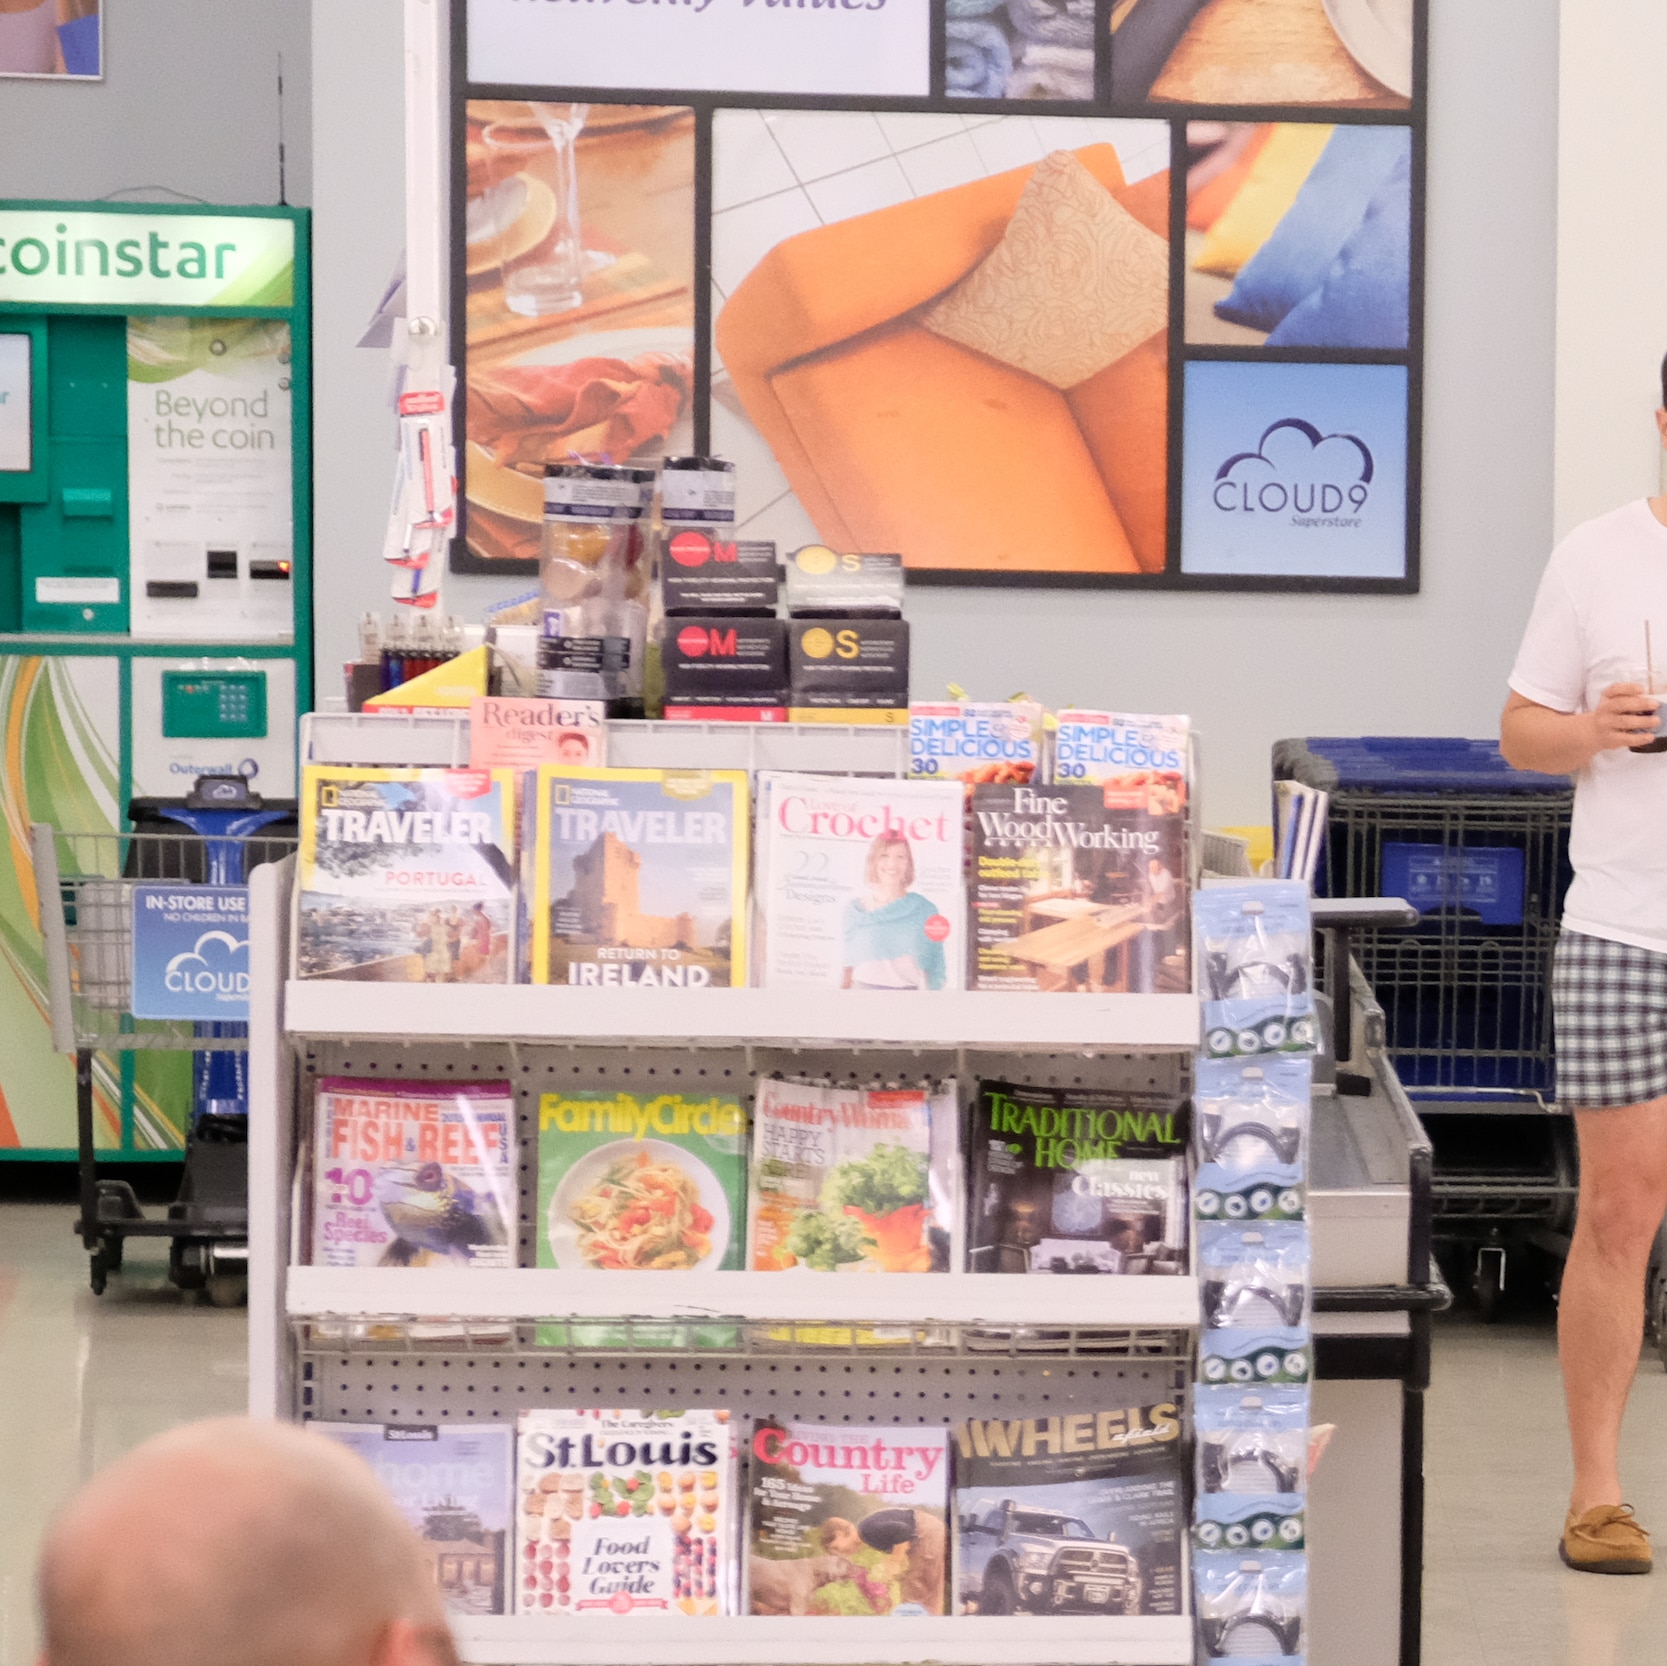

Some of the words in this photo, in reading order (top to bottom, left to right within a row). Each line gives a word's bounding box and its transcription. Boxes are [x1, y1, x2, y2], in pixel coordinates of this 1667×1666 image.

[0, 222, 237, 280] oinstar
[154, 389, 270, 423] Beyond
[154, 420, 205, 450] the
[211, 424, 276, 451] coin
[1213, 481, 1368, 514] CLOUD9
[1289, 515, 1363, 528] Superstore
[714, 541, 738, 563] M
[710, 628, 737, 657] M
[835, 629, 861, 660] S
[483, 701, 601, 727] Reader's
[505, 728, 554, 743] digest
[910, 718, 990, 738] SIMPLE
[1058, 725, 1139, 747] SIMPLE
[911, 738, 1031, 759] DELICIOUS
[1058, 742, 1180, 768] DELICIOUS
[910, 758, 939, 775] 30
[1057, 762, 1087, 779] 30
[1013, 787, 1069, 814] Fine
[321, 809, 492, 844] TRAVELER
[554, 807, 727, 844] TRAVELER
[778, 796, 951, 842] Crochet
[385, 871, 488, 886] PORTUGAL
[145, 895, 215, 911] IN-STORE
[218, 896, 247, 912] USE
[597, 947, 657, 961] RETURN
[661, 948, 681, 961] TO
[165, 971, 250, 993] CLOUD
[568, 961, 712, 987] IRELAND
[332, 1097, 439, 1122] MARINE
[984, 1091, 1181, 1143] TRADITIONAL
[332, 1118, 404, 1163] FISH
[763, 1123, 821, 1147] HAPPY
[762, 1141, 825, 1166] STARTS
[1034, 1136, 1122, 1170] HOME
[1072, 1175, 1168, 1199] Classics
[753, 1427, 944, 1481] Country
[860, 1474, 916, 1495] Life
[594, 1535, 651, 1556] Food
[582, 1556, 661, 1575] Lovers
[589, 1576, 656, 1596] Guide
